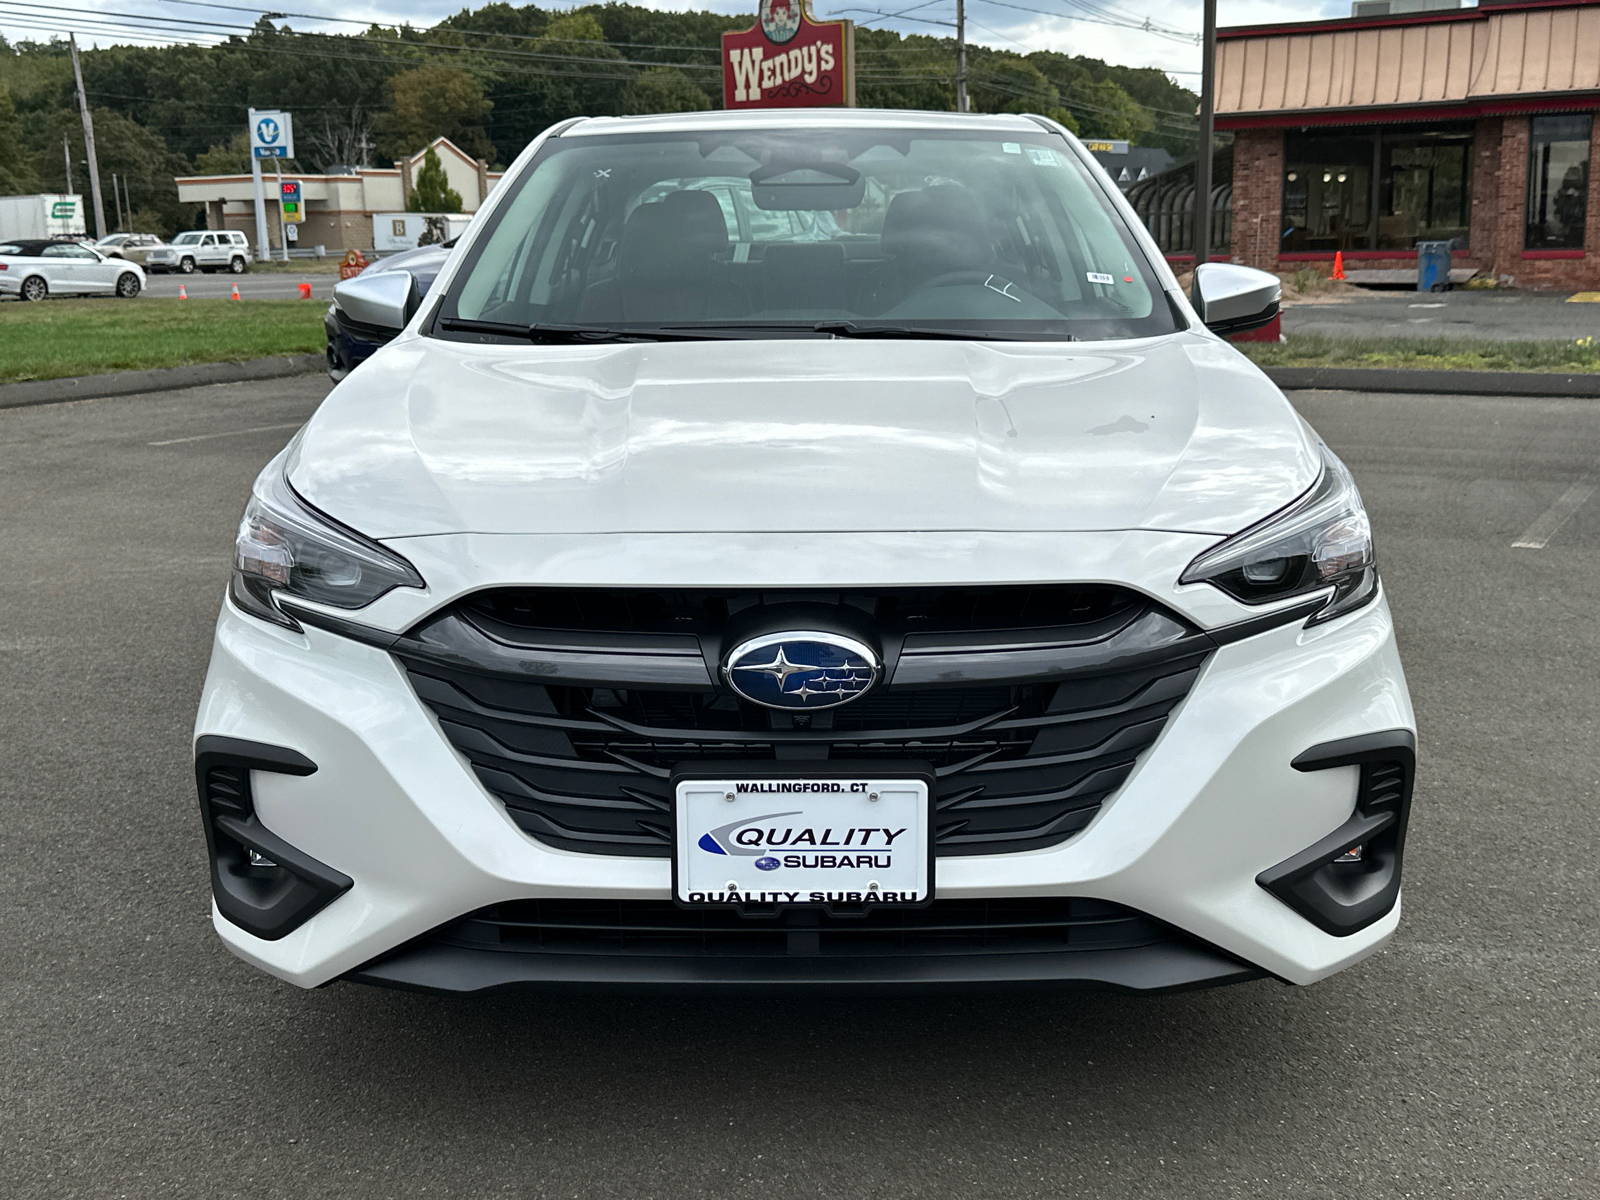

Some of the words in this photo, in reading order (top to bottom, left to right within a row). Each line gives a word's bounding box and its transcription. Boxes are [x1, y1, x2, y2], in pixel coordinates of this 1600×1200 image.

[395, 222, 404, 235] B
[850, 783, 869, 793] CT
[735, 828, 907, 847] QUALITY
[783, 855, 892, 868] SUBARU
[688, 892, 800, 903] QUALITY
[809, 892, 918, 903] SUBARU
